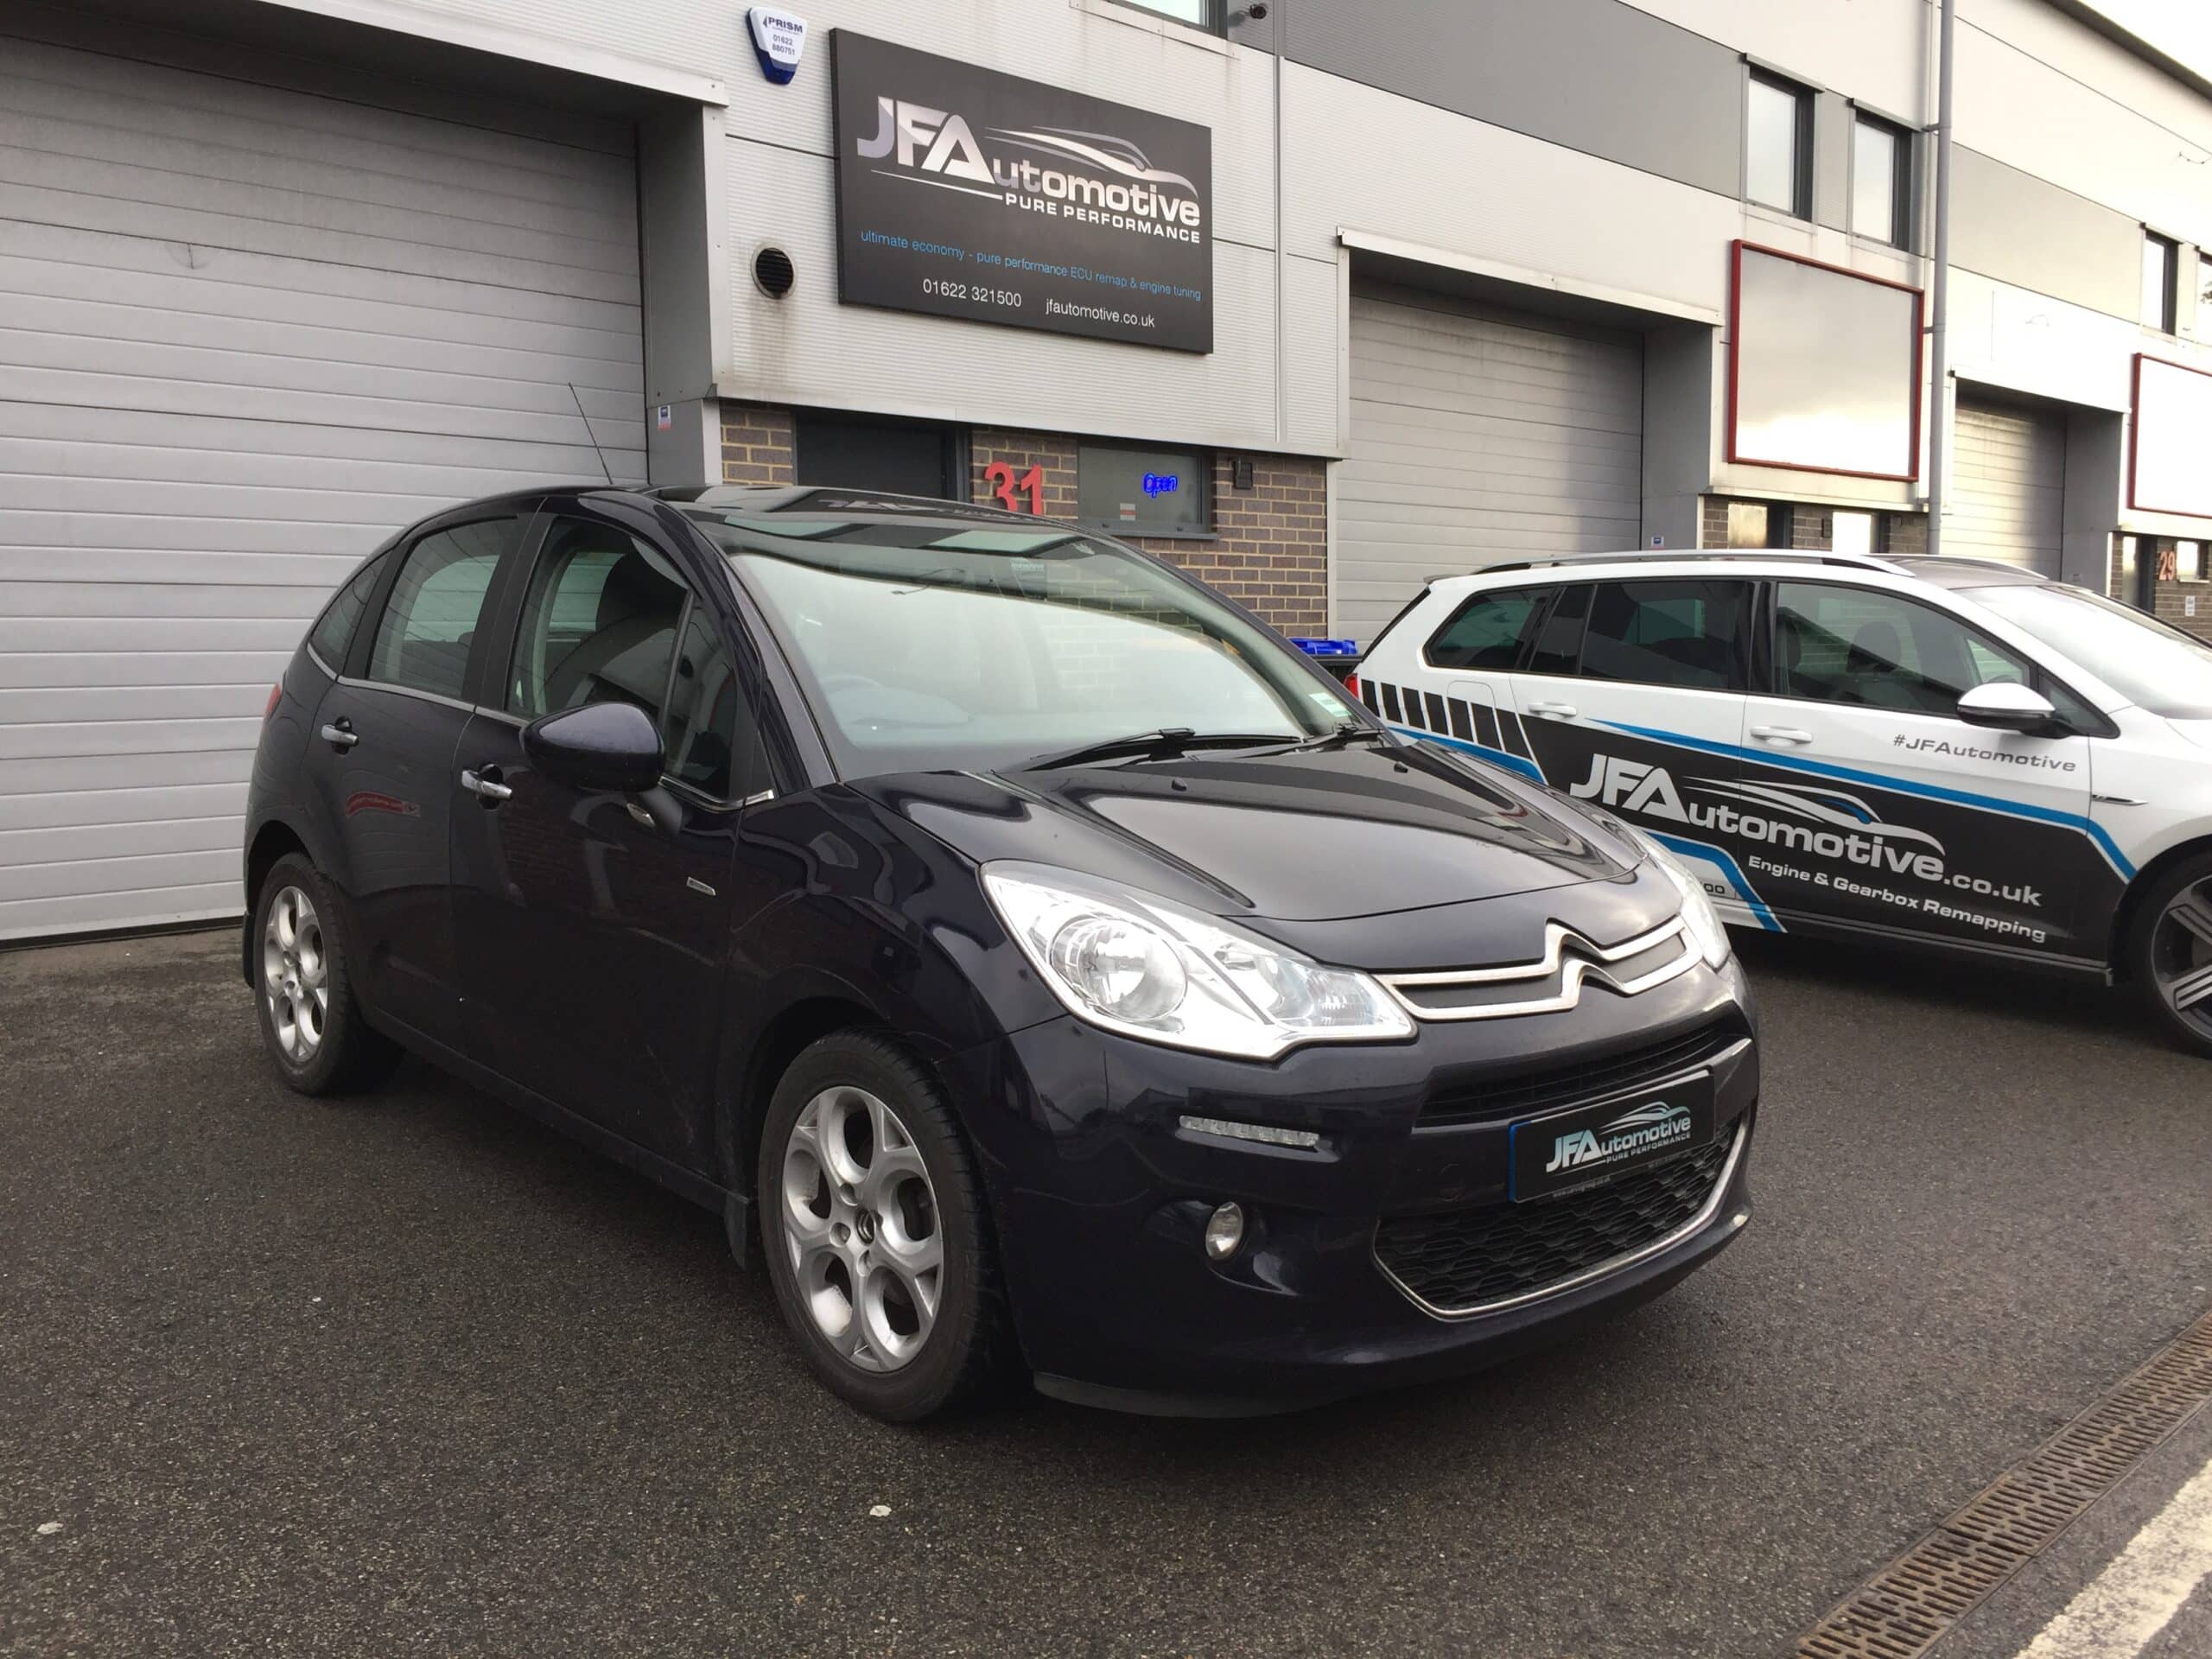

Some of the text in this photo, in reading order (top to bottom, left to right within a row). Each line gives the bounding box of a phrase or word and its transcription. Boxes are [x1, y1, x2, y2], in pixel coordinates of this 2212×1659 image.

[768, 16, 803, 33] PRISM
[772, 34, 793, 46] 01622
[1005, 192, 1200, 244] PURE PERFORMANCE
[861, 230, 908, 249] ultimate
[912, 240, 965, 260] economy
[976, 251, 1001, 265] pure
[1004, 257, 1068, 277] performance
[1071, 266, 1093, 282] ECU
[1095, 273, 1128, 288] remap
[1130, 277, 1137, 289] &
[1140, 281, 1172, 296] engine
[1173, 286, 1202, 302] tuning
[923, 278, 1155, 327] 01622 321500 jfautomotive.co.uk
[984, 461, 1042, 516] 31
[2158, 550, 2176, 582] 29
[1893, 734, 2076, 772] #JFAutomotive
[1748, 855, 2046, 944] Engine & Gearbox Remapping
[1606, 1150, 1630, 1163] PURE
[1630, 1131, 1691, 1156] PERFORMANCE
